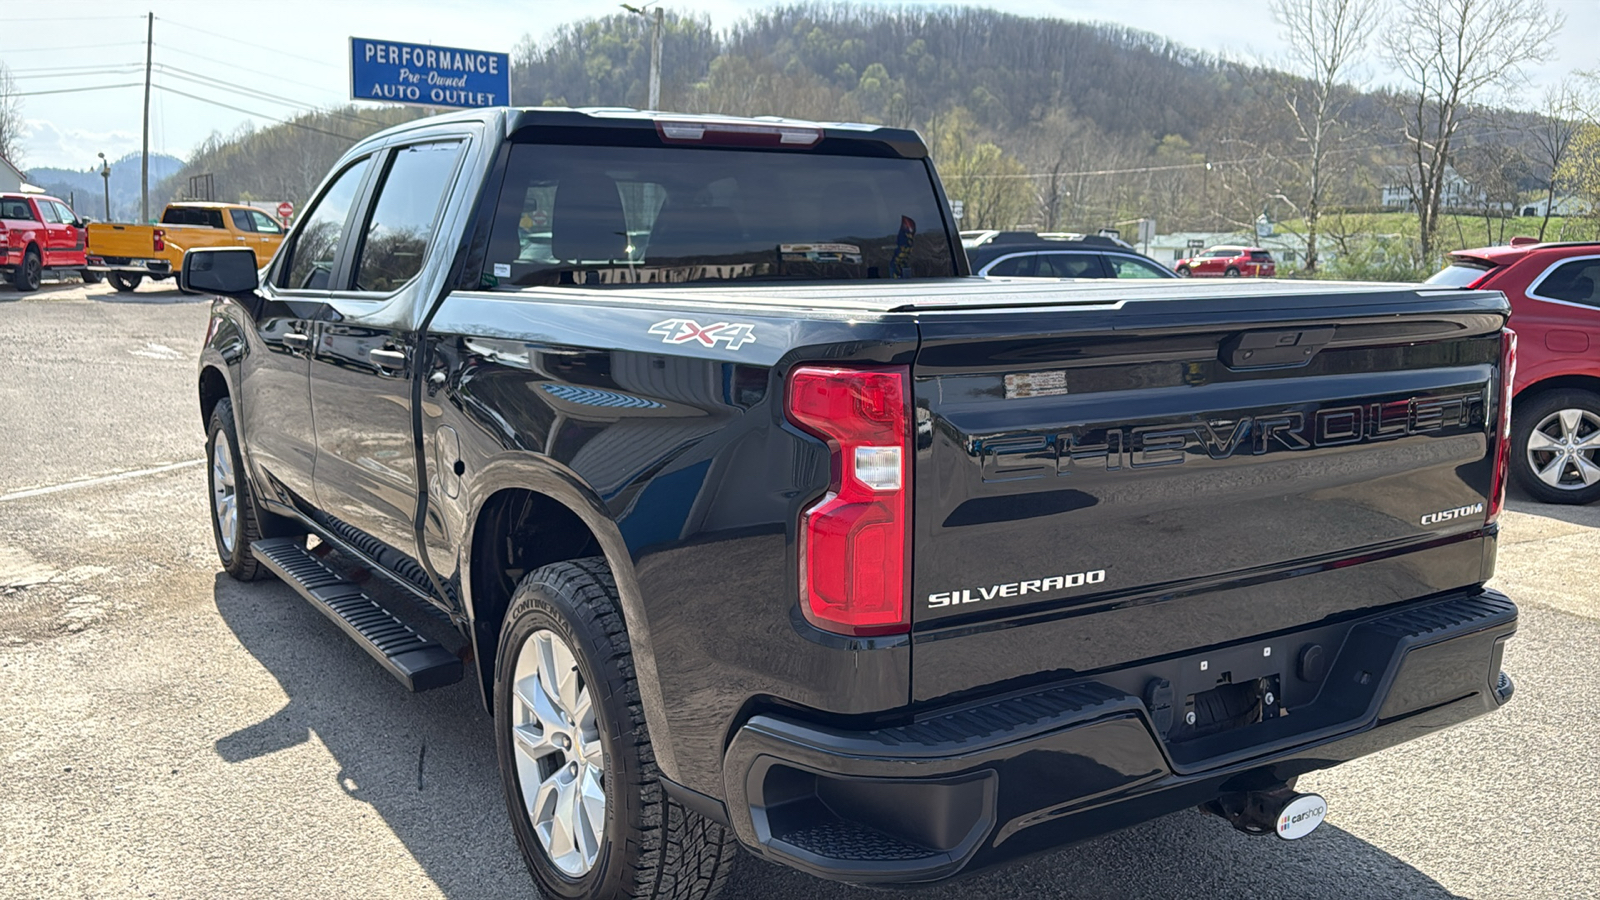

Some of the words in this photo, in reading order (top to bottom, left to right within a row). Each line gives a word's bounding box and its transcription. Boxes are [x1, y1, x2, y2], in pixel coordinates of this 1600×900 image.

[365, 43, 499, 75] PERFORMANCE
[399, 68, 468, 88] Pre-Owned
[371, 83, 421, 100] AUTO
[430, 88, 496, 106] OUTLET
[1420, 502, 1483, 525] CUSTOM
[928, 569, 1106, 608] SILVERADO
[511, 598, 575, 641] CONTINENTAL
[1291, 806, 1324, 823] carshop
